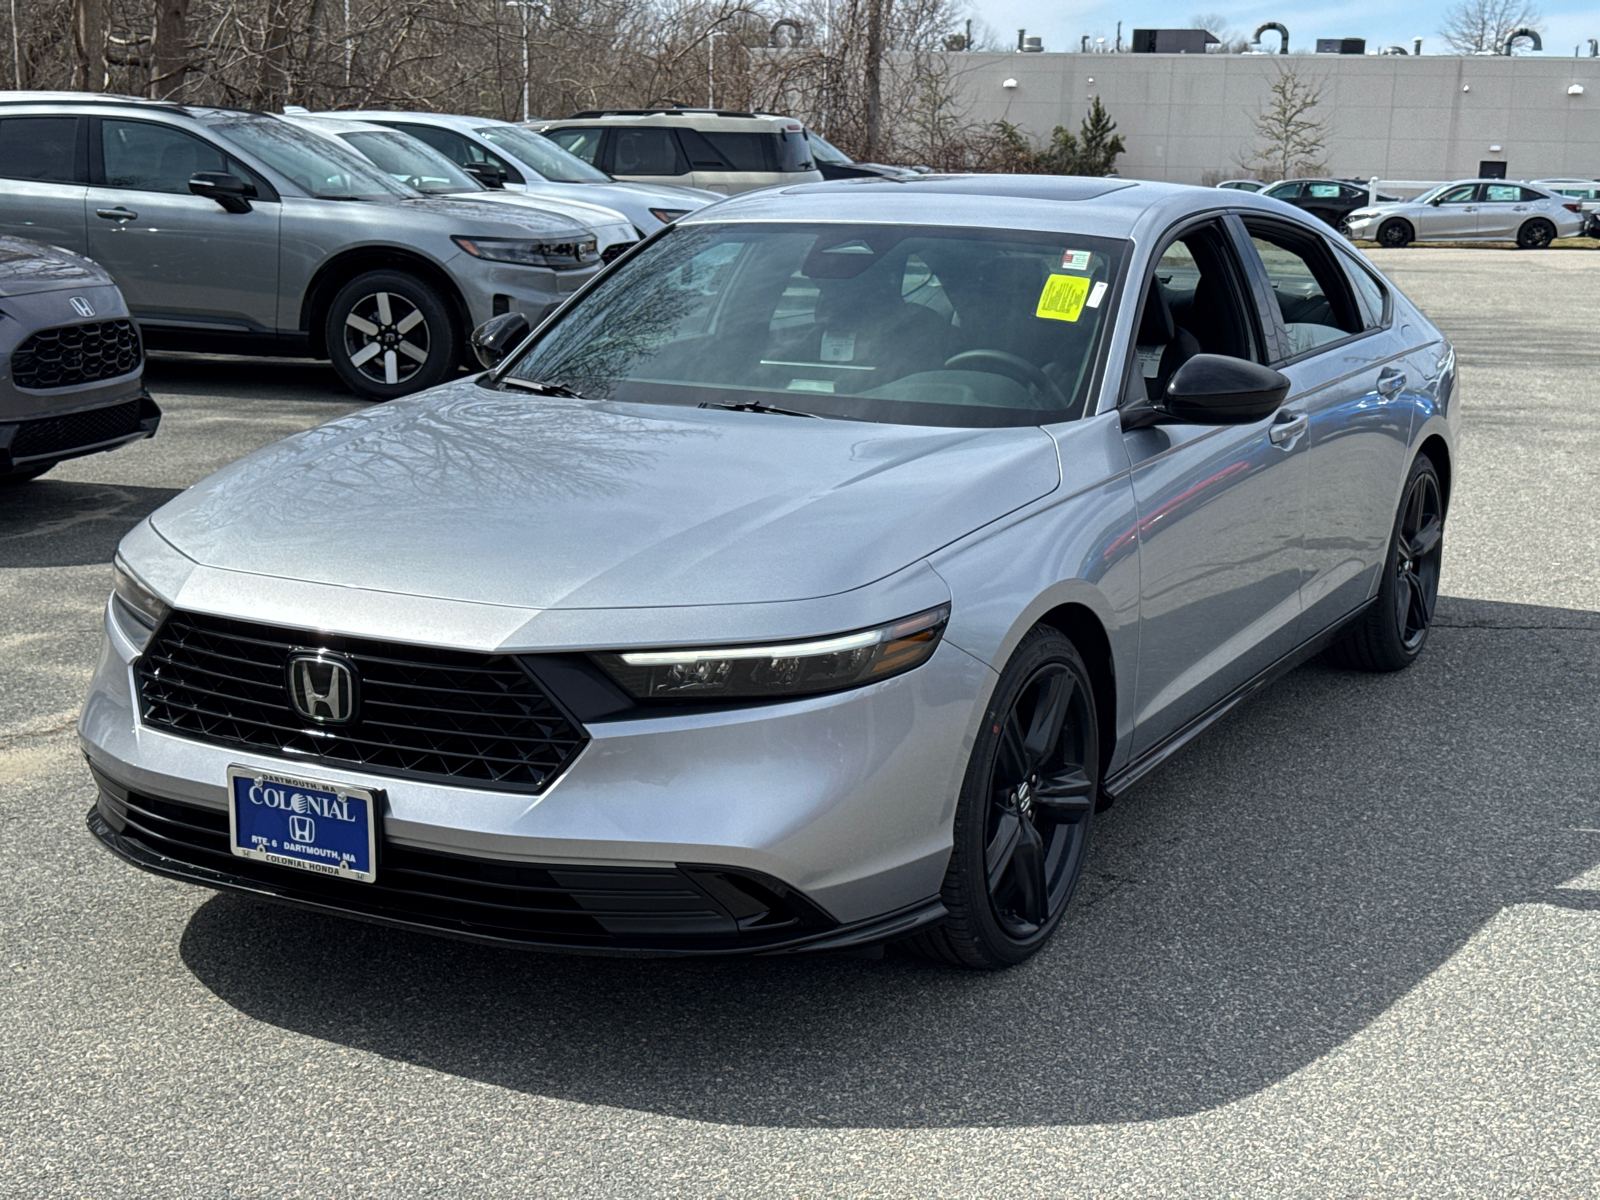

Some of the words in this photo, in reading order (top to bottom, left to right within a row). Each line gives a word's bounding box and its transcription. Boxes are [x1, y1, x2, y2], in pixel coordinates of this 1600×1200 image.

[322, 785, 336, 793] MA
[249, 785, 356, 822] COLONIAL
[251, 835, 270, 847] RTE.
[271, 840, 278, 848] 6
[283, 841, 341, 861] DARTMOUTH,
[342, 852, 356, 863] MA
[266, 854, 307, 869] COLONIAL
[308, 862, 340, 876] HONDA
